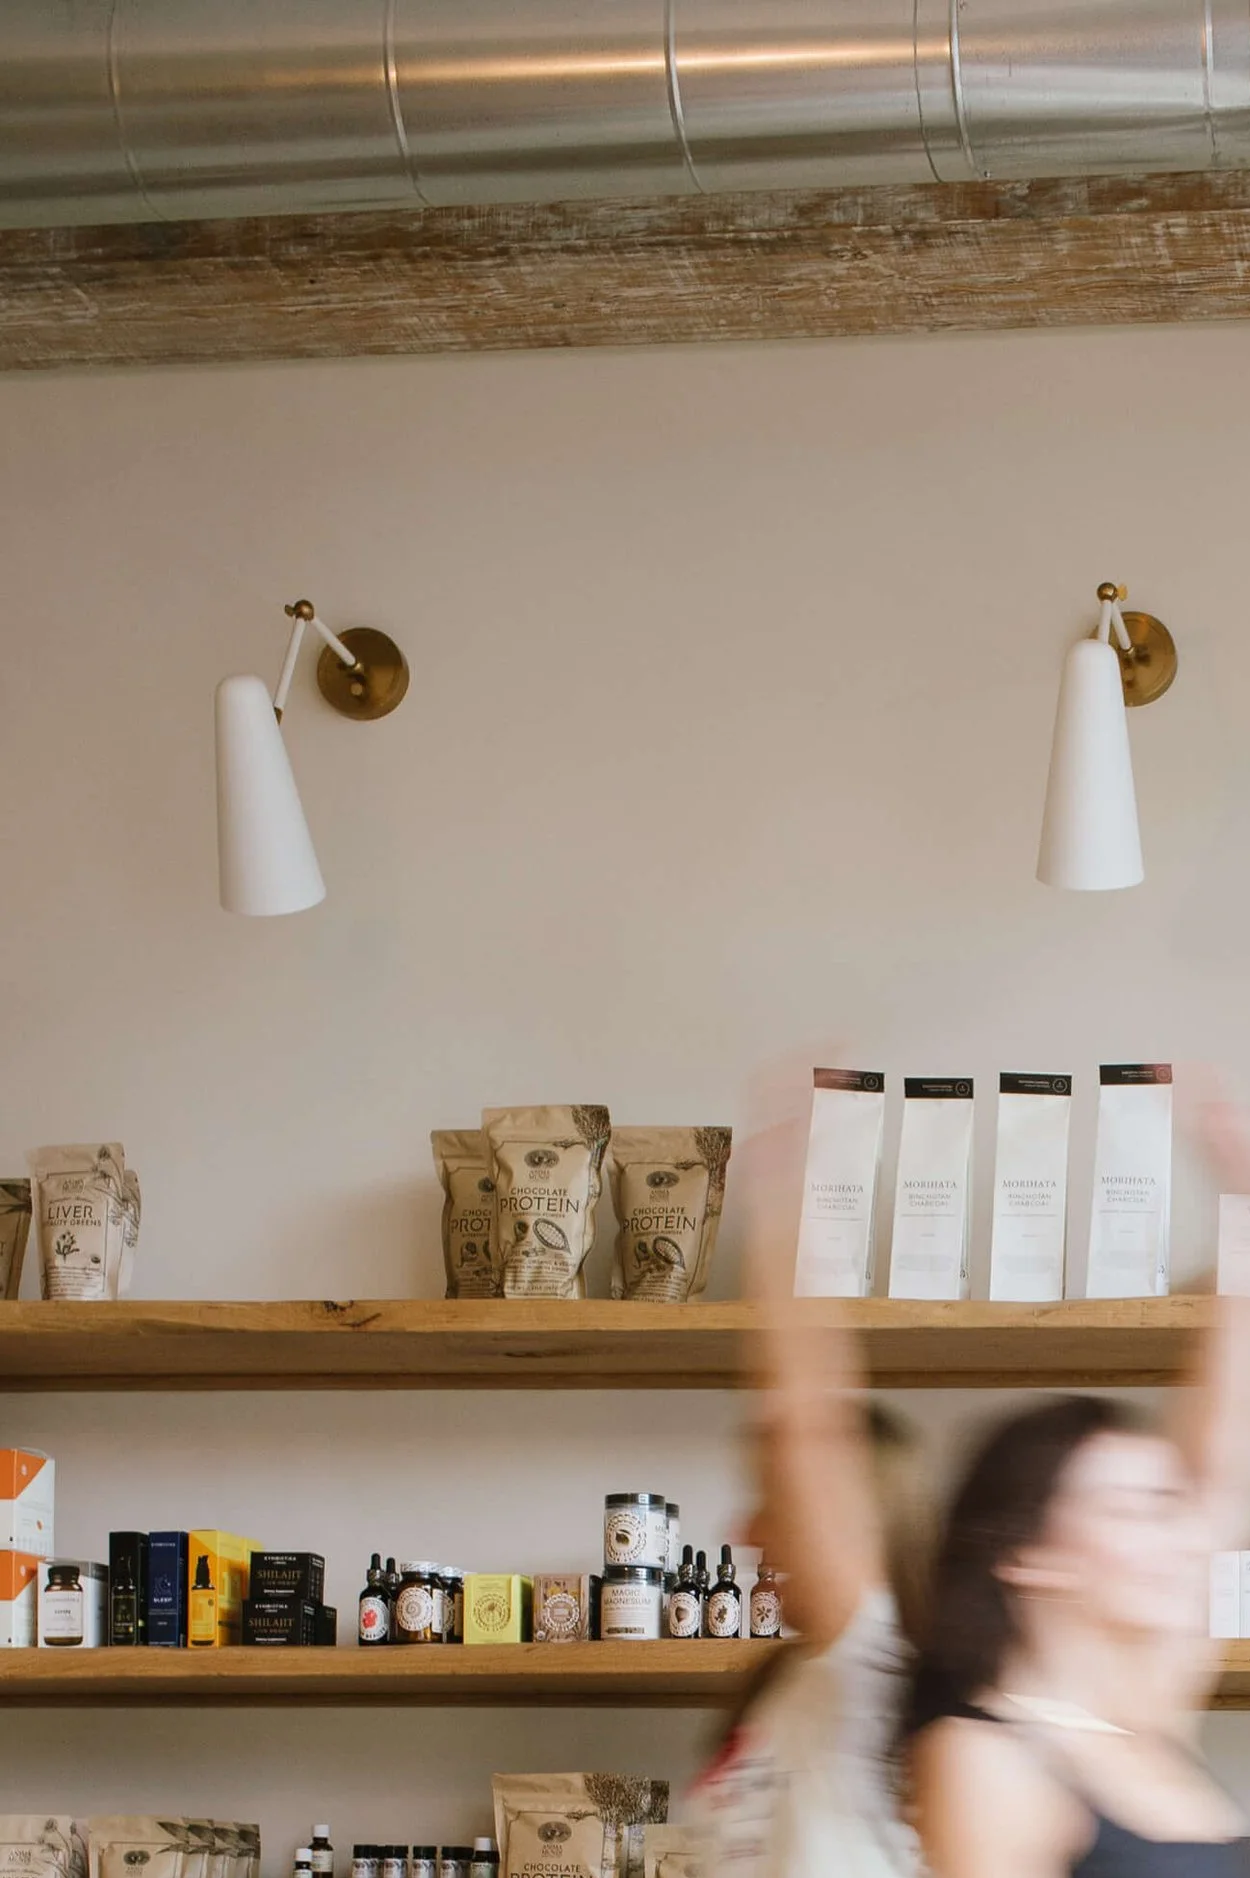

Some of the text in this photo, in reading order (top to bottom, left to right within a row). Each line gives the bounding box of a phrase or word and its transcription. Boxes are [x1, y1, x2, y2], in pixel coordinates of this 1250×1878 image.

[510, 1187, 568, 1196] CHOCOLATE
[48, 1205, 94, 1220] LIVER
[500, 1196, 581, 1214] PROTEIN
[632, 1207, 685, 1216] CHOCOLATE
[449, 1218, 491, 1233] PROT
[622, 1215, 697, 1233] PROTEIN
[523, 1863, 581, 1873] CHOCOLATE
